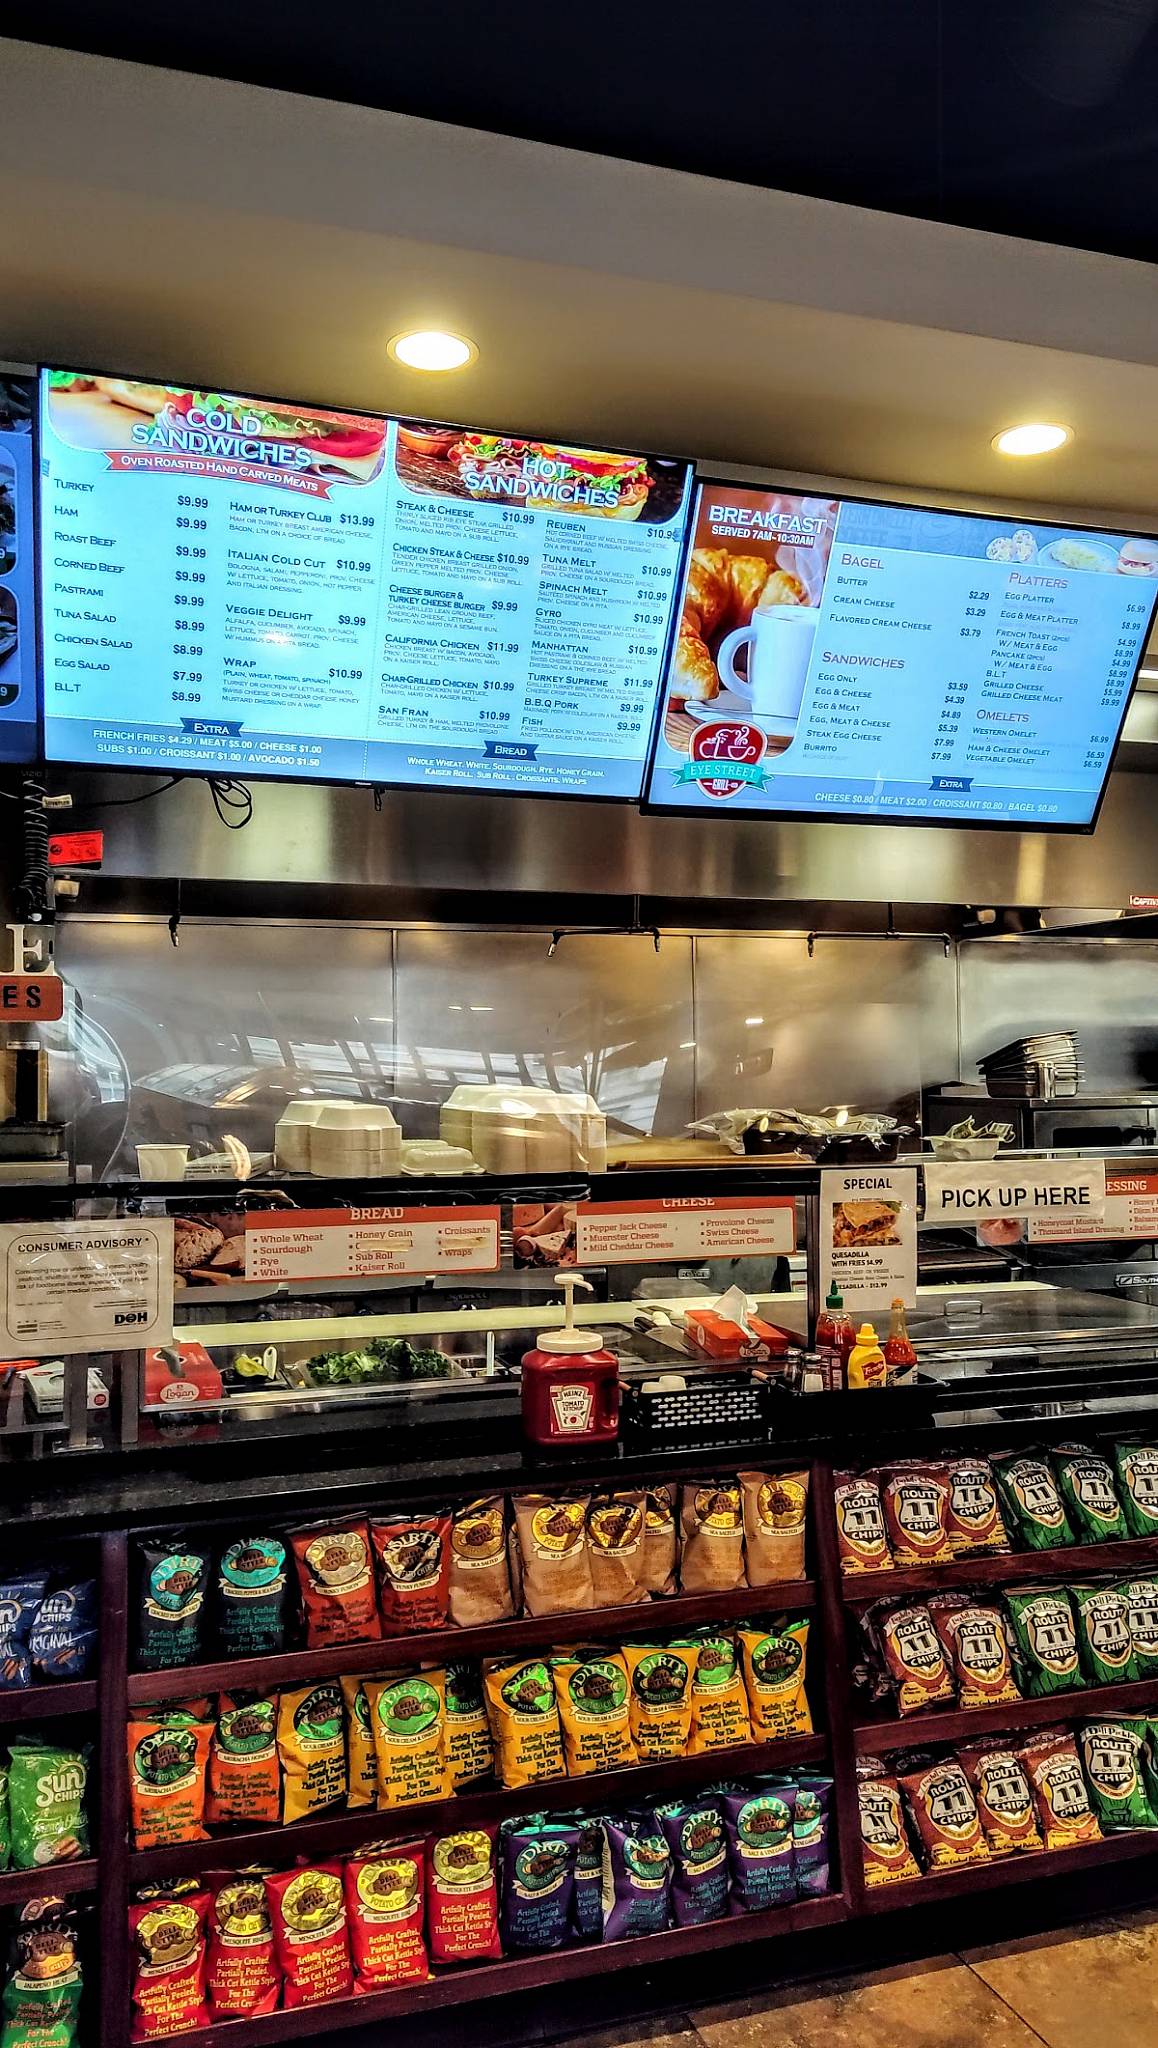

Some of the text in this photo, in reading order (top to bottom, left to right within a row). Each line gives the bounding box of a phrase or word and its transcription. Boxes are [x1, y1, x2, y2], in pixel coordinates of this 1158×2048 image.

[187, 407, 262, 438] COLD
[131, 422, 314, 467] SANDWICHES
[121, 455, 320, 493] OVEN ROASTED HAND CARVED MEATS
[522, 457, 572, 480] HOT
[54, 478, 209, 508] TURKEY $9.99
[464, 471, 620, 509] SANDWICHES
[54, 505, 208, 530] HAM $9.99
[229, 501, 375, 527] HAM OR TURKEY CLUB $13.99
[396, 500, 427, 513] STEAK
[437, 505, 475, 519] CHEESE
[502, 511, 535, 525] $10.99
[709, 505, 828, 534] BREAKFAST
[546, 519, 586, 532] REUBEN
[711, 524, 751, 539] SERVED
[54, 531, 207, 558] ROAST BEEF $9.99
[227, 549, 372, 572] ITALIAN COLD CUT $10.99
[542, 553, 569, 566] TUNA
[570, 557, 597, 568] MELT
[641, 565, 672, 577] $10.99
[841, 553, 885, 570] BAGEL
[54, 557, 206, 583] CORNED BEEF $9.99
[1008, 572, 1070, 590] PLATTERS
[54, 582, 205, 607] PASTRAMI $9.99
[837, 576, 990, 601] BUTTER $2.29
[54, 608, 206, 632] TUNA SALAD $8.99
[225, 604, 366, 627] VEGGIE DELIGHT $9.99
[535, 607, 664, 625] GYRO $10.99
[54, 633, 204, 656] CHICKEN SALAD $8.99
[385, 633, 519, 654] CALIFORNIA CHICKEN $11.99
[822, 651, 906, 669] SANDWICHES
[54, 657, 203, 683] EGG SALAD $7.99
[223, 657, 363, 680] WRAP $10.99
[171, 691, 202, 703] $8.99
[379, 705, 399, 714] SAN
[401, 707, 429, 718] FRAN
[479, 710, 510, 721] $10.99
[976, 709, 1030, 723] OMELETS
[193, 723, 230, 736] EXTRA
[616, 721, 641, 731] $9.99
[494, 745, 527, 757] BREAD
[803, 743, 952, 761] BURRITO $7.99
[690, 763, 757, 779] EYE STREET
[843, 1178, 893, 1190] SPECIAL
[1106, 1180, 1147, 1192] ESSING
[662, 1197, 716, 1208] CHEESE
[941, 1186, 1091, 1208] PICK UP HERE
[351, 1206, 404, 1220] BREAD
[589, 1221, 668, 1233] Pepper Jack Cheese
[705, 1216, 775, 1227] Provolone Cheese
[355, 1229, 413, 1242] Honey Grain
[444, 1225, 491, 1235] Croissants
[589, 1232, 659, 1242] Muenster Cheese
[706, 1227, 760, 1236] Swiss Cheese
[17, 1237, 142, 1253] CONSUMER ADVISORY
[260, 1233, 324, 1244] Whole Wheat
[706, 1236, 775, 1247] American Cheese
[260, 1244, 313, 1255] Sourdough
[589, 1240, 674, 1252] Mild Cheddar Cheese
[355, 1251, 393, 1261] Sub Roll
[444, 1248, 473, 1259] Wraps
[831, 1251, 869, 1259] QUESADILLA
[260, 1256, 279, 1268] Rye
[355, 1261, 405, 1272] Kaiser Roll
[260, 1268, 289, 1277] White
[563, 1390, 583, 1398] HEINZ
[953, 1475, 986, 1486] ROUTE
[960, 1505, 990, 1516] CHIPS
[1034, 1613, 1067, 1626] ROUTE
[960, 1624, 994, 1636] ROUTE
[1045, 1648, 1075, 1659] CHIPS
[970, 1659, 999, 1668] CHIPS
[987, 1767, 1020, 1780] ROUTE
[35, 1761, 87, 1808] Sun
[54, 1789, 85, 1803] CHIPS
[992, 1801, 1028, 1812] CHIPS
